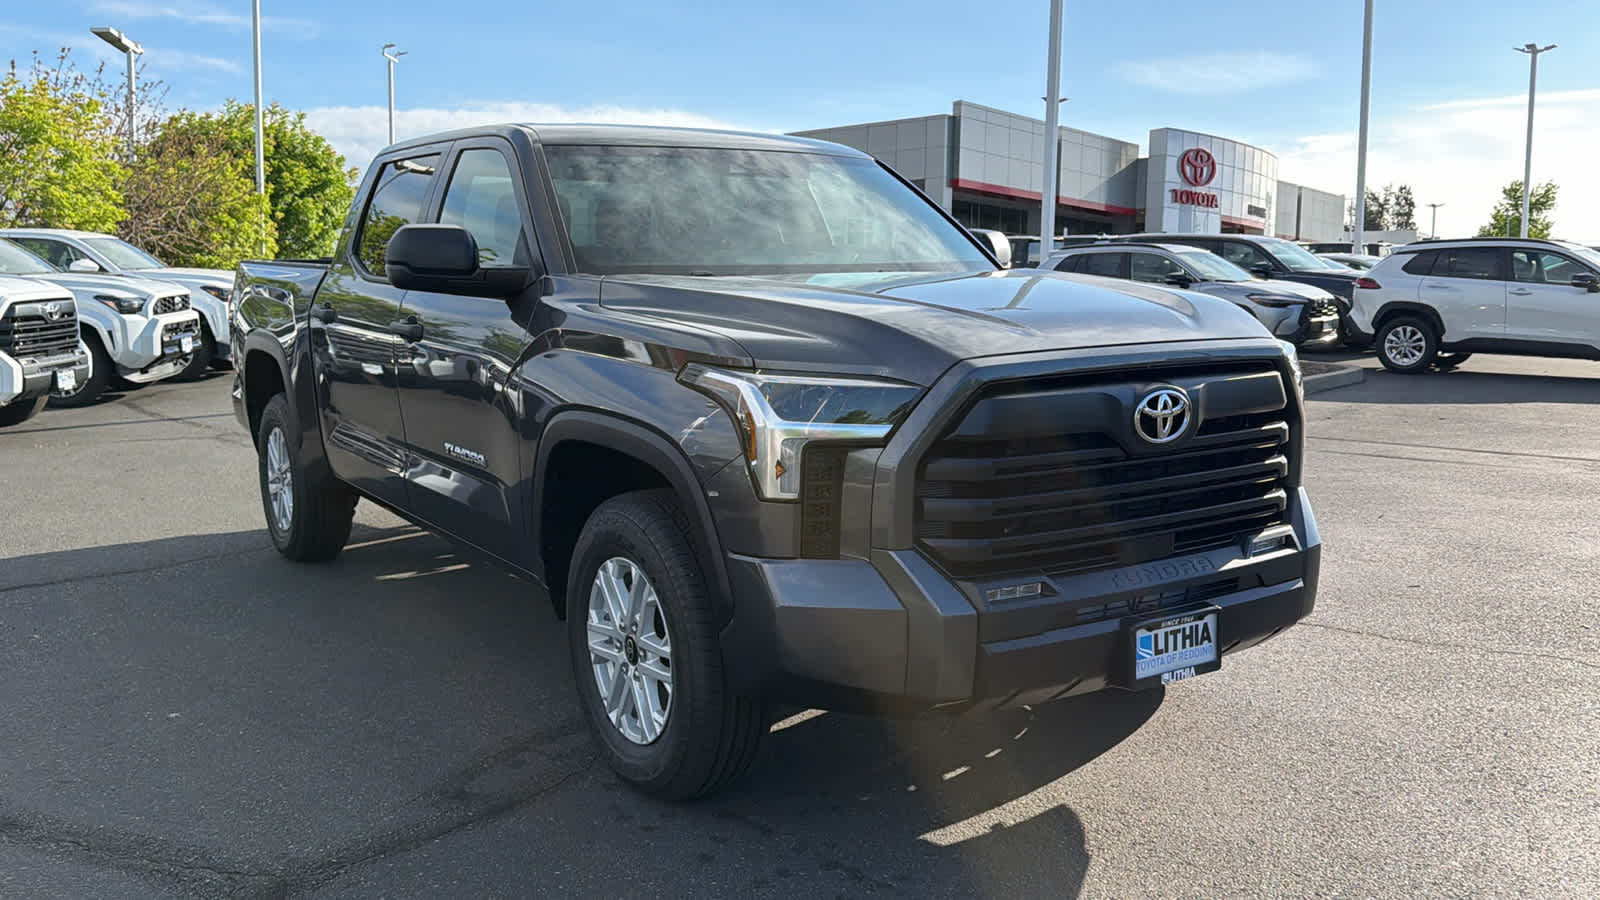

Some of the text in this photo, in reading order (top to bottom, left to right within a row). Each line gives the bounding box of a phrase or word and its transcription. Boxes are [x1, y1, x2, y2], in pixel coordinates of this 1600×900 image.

[1171, 188, 1219, 209] TOYOTA
[443, 441, 487, 467] TUNDRA
[1111, 557, 1216, 588] TUNDRA
[1153, 621, 1212, 656] LITHIA
[1136, 644, 1214, 673] TOYOTA OF REDDING
[1169, 666, 1196, 681] LITHIA
